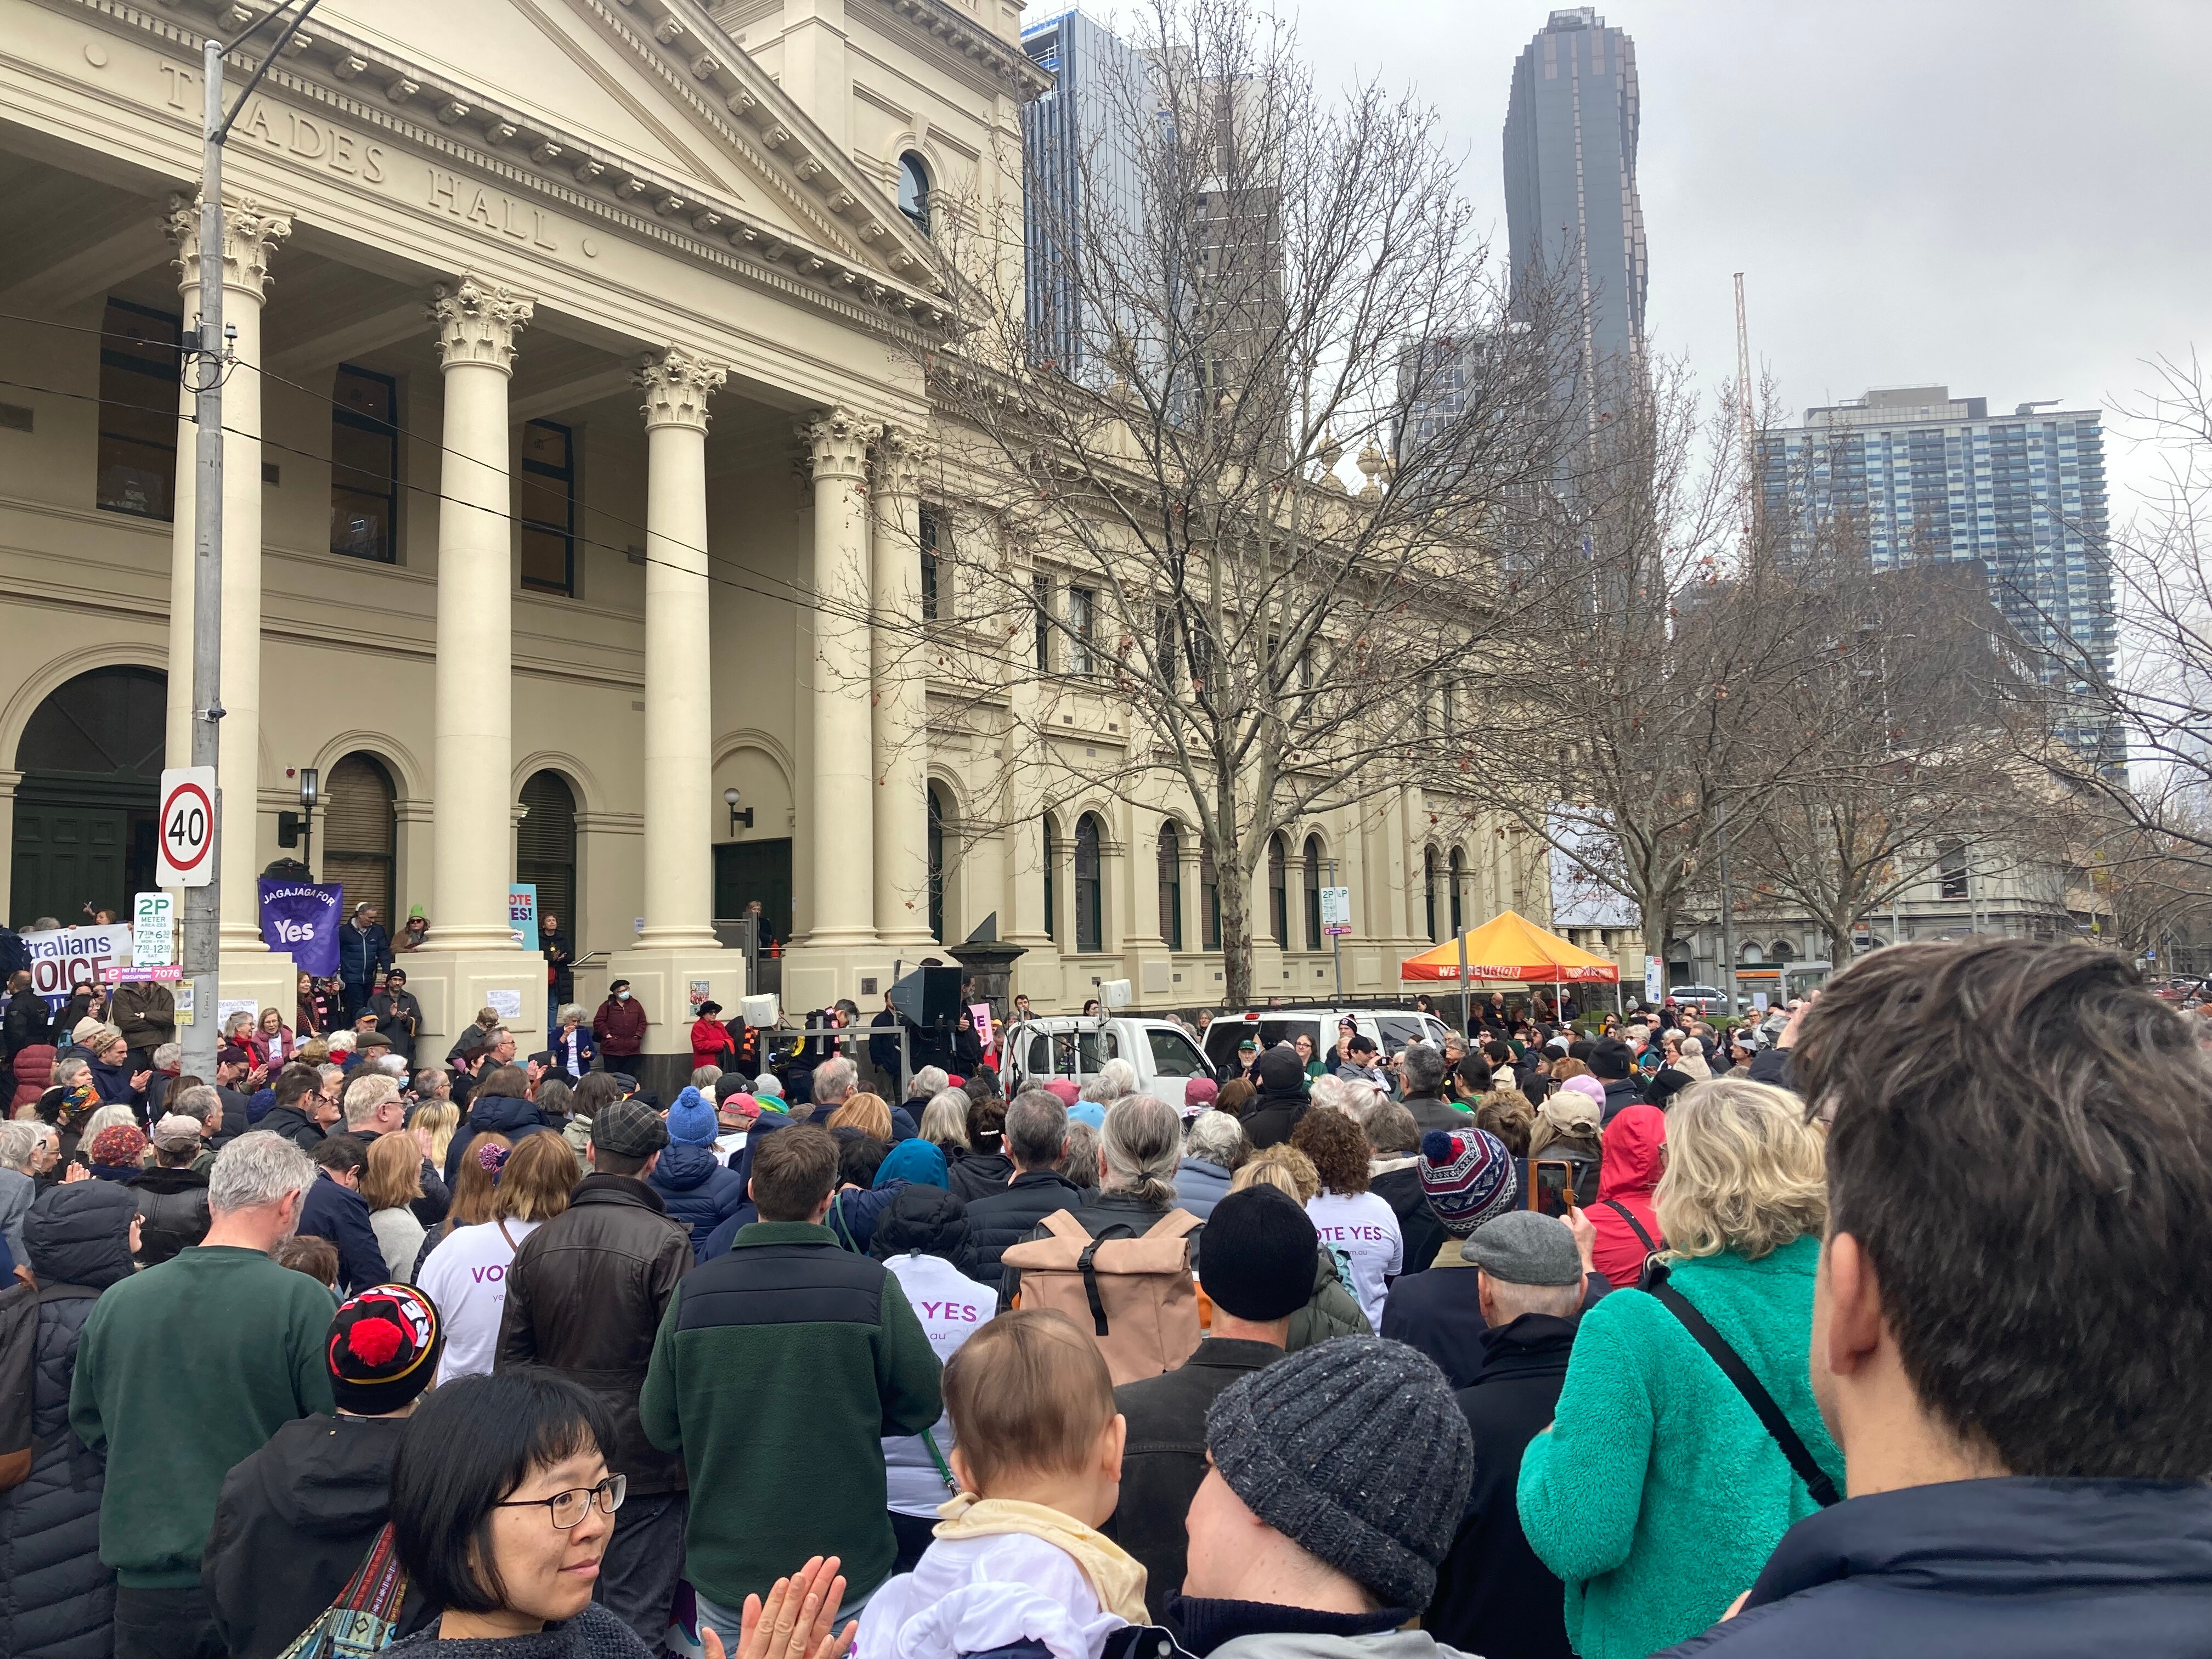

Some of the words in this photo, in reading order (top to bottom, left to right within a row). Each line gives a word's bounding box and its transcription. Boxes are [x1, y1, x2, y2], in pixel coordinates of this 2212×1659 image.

[160, 60, 386, 184] TADES
[428, 168, 556, 251] HALL
[168, 808, 204, 846] 40
[139, 899, 169, 915] 2P
[264, 888, 316, 905] JAGAJAGA
[316, 890, 335, 907] FOR
[509, 894, 532, 906] OTE
[509, 907, 533, 921] ES!
[274, 919, 314, 944] Yes
[26, 934, 111, 959] tralians
[30, 956, 113, 992] OICE
[154, 969, 180, 978] 7076
[1439, 966, 1457, 976] WE
[1458, 966, 1480, 976] RE
[1483, 966, 1519, 978] UNION
[1349, 1227, 1382, 1240] YES
[922, 1302, 977, 1322] YES
